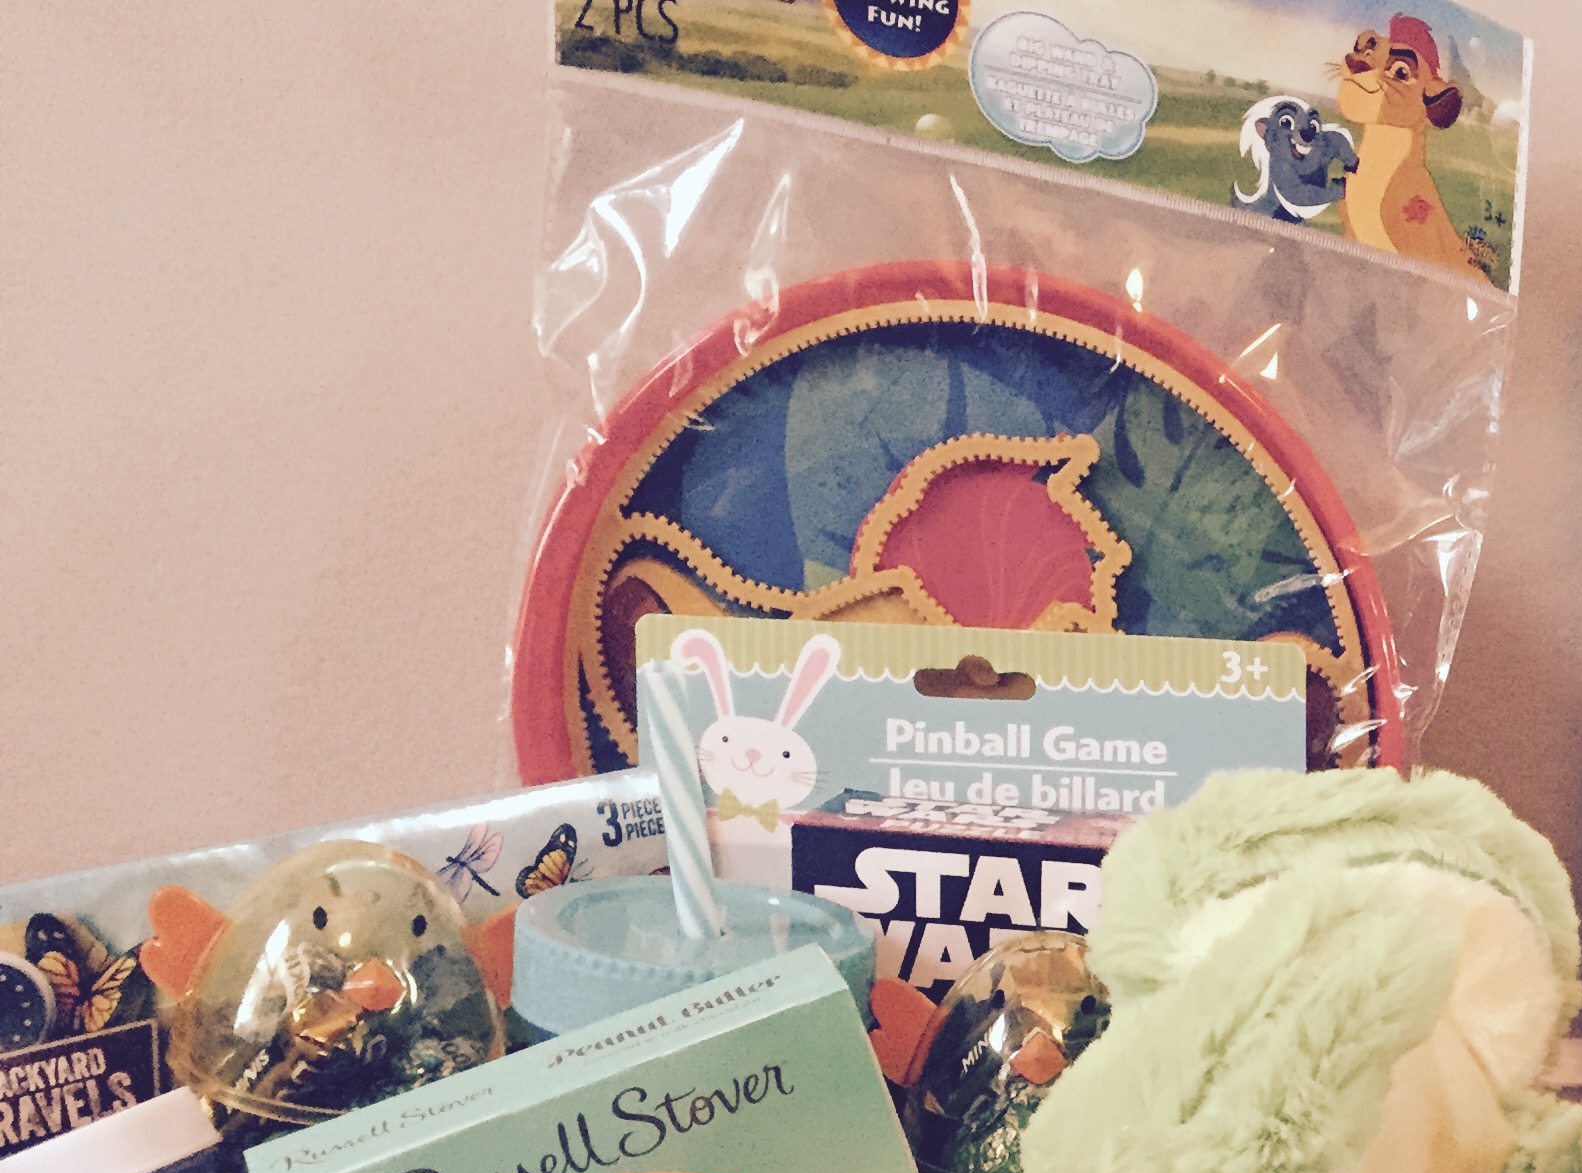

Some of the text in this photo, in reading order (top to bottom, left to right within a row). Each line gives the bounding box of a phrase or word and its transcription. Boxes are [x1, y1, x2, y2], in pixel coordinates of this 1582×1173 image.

[613, 0, 679, 43] PCS
[867, 5, 921, 32] FUN!
[1221, 650, 1268, 683] 3+
[886, 718, 1167, 764] Pinball Game
[967, 772, 1019, 806] de
[1031, 775, 1165, 813] billard
[597, 800, 622, 847] 3
[814, 846, 1106, 930] STAR
[0, 1048, 106, 1099] ACKYARD
[0, 1072, 137, 1147] RAVELS
[611, 1064, 795, 1158] Stover
